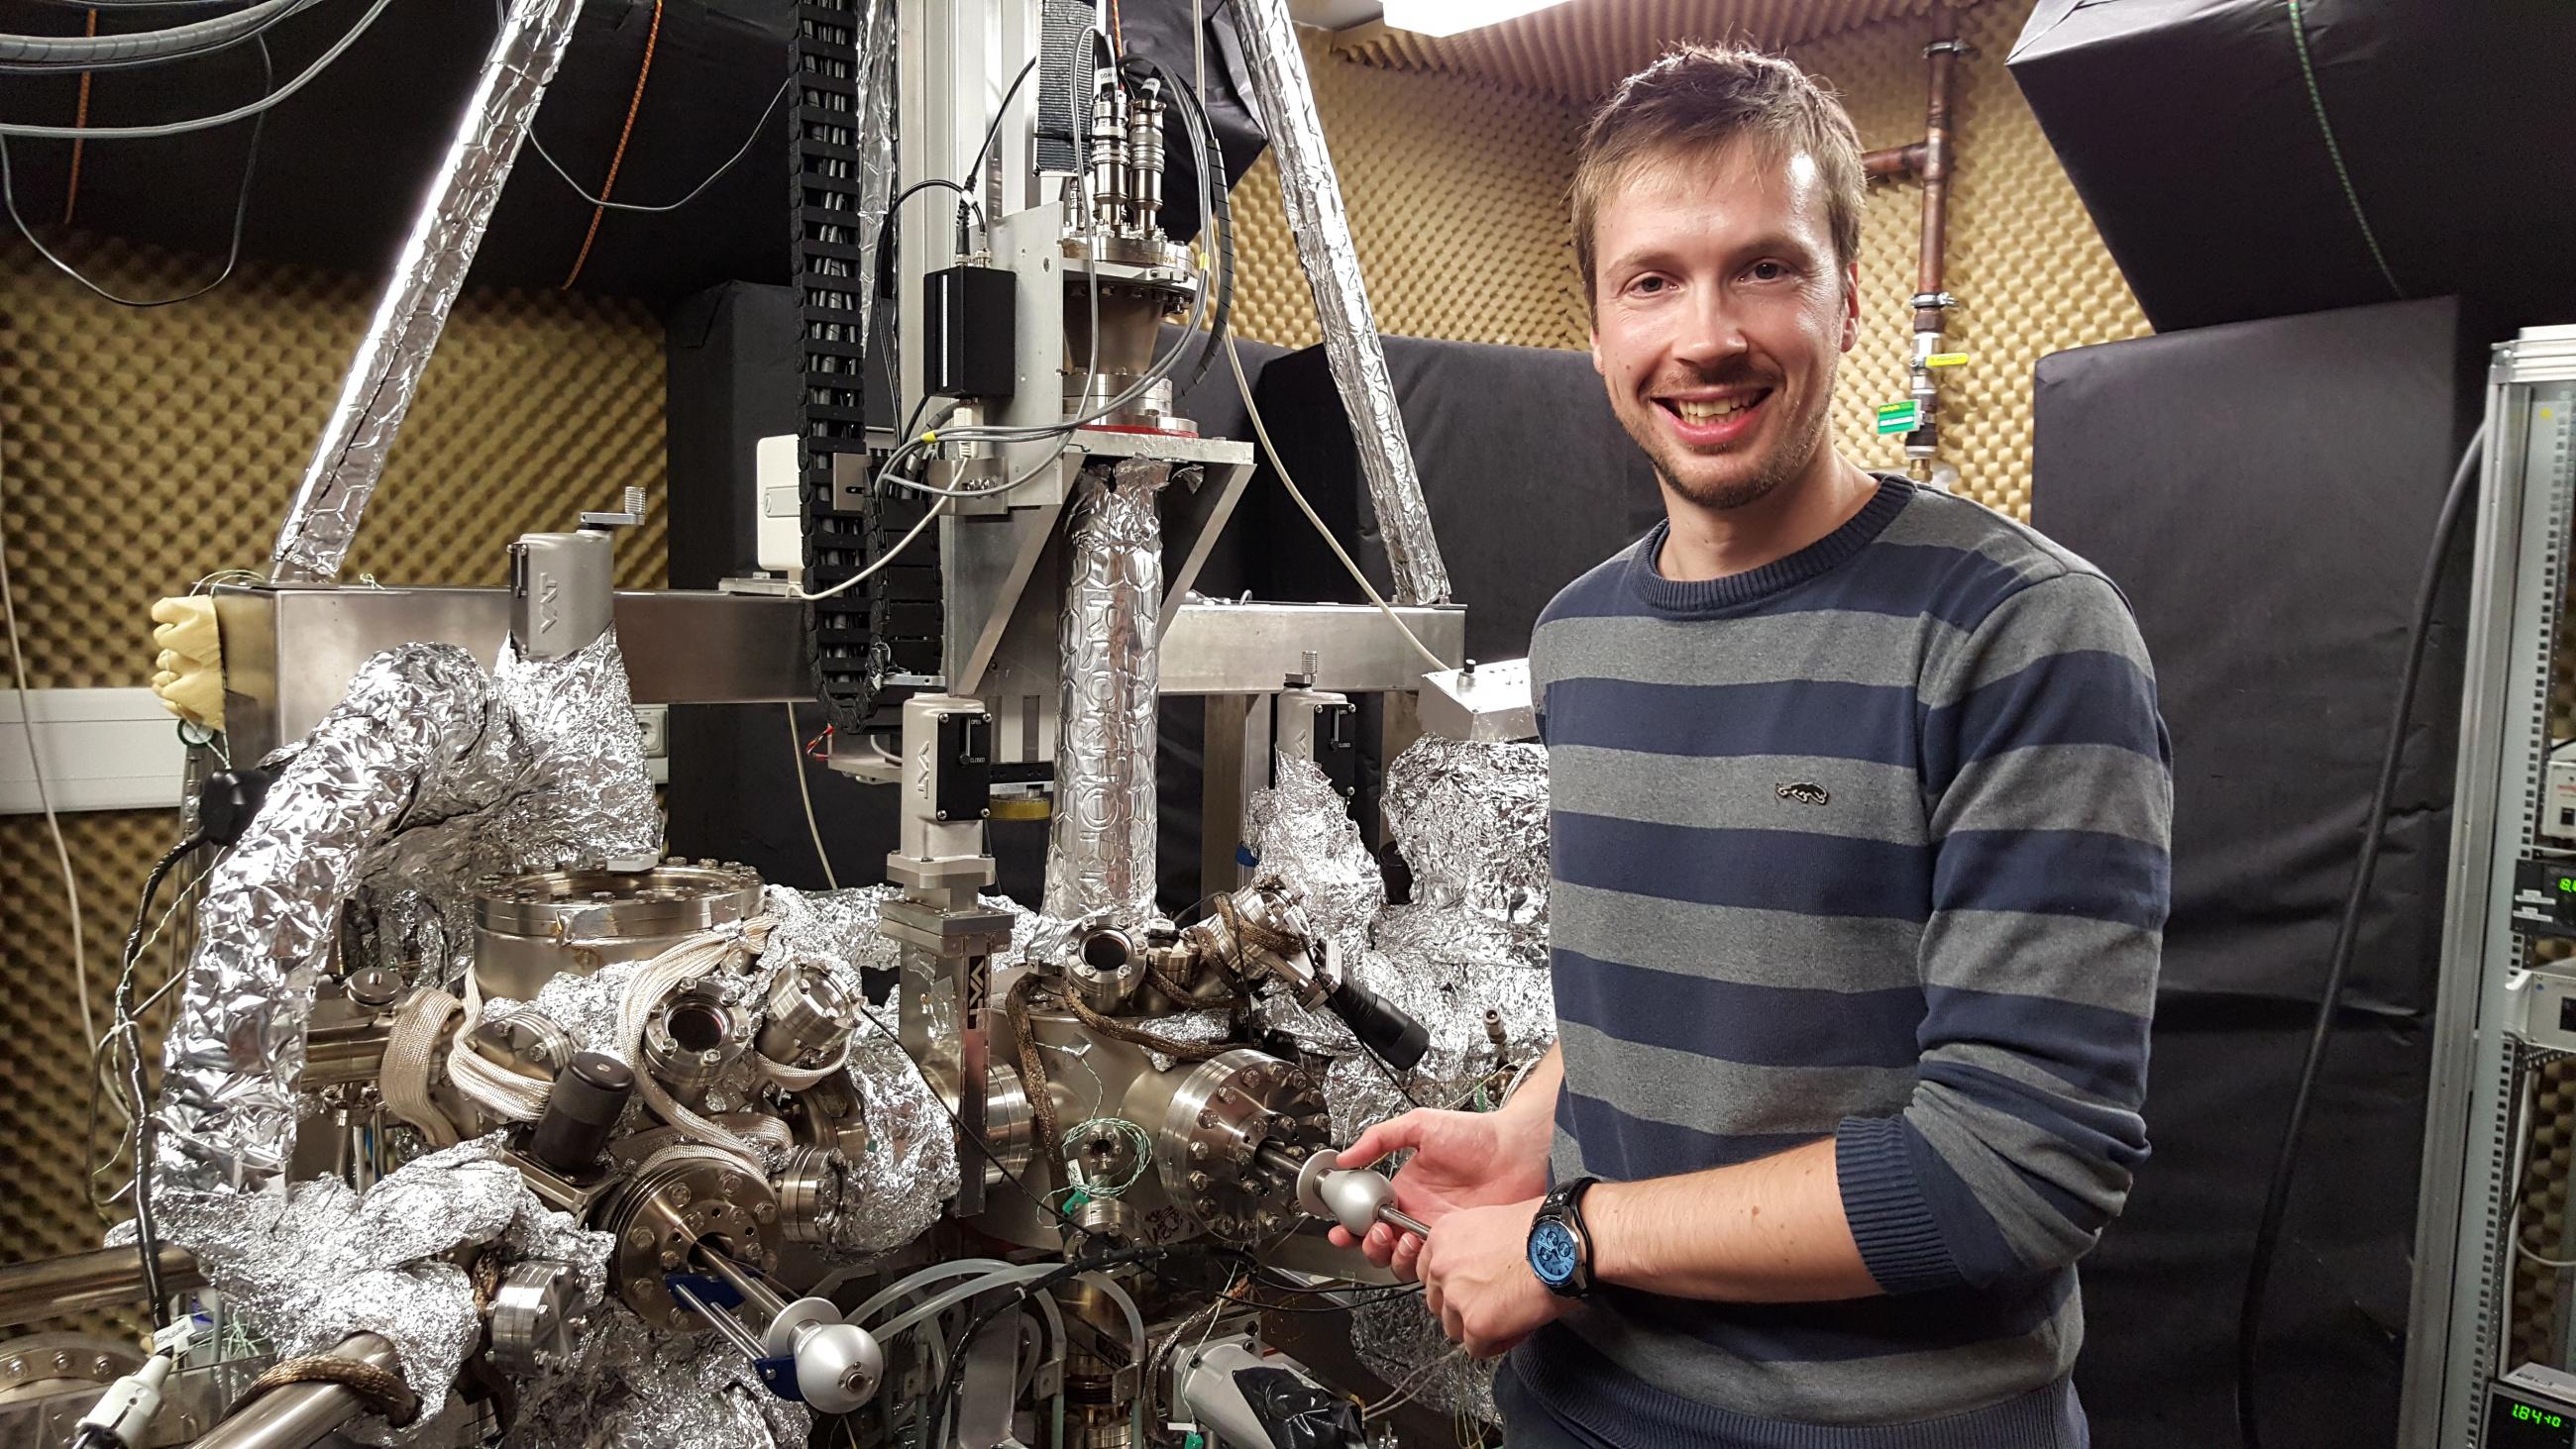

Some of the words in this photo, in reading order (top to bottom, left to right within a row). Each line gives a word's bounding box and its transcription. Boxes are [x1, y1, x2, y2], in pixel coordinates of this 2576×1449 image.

[539, 571, 558, 635] VAT
[917, 740, 930, 800] VAT
[969, 959, 985, 1023] VAT
